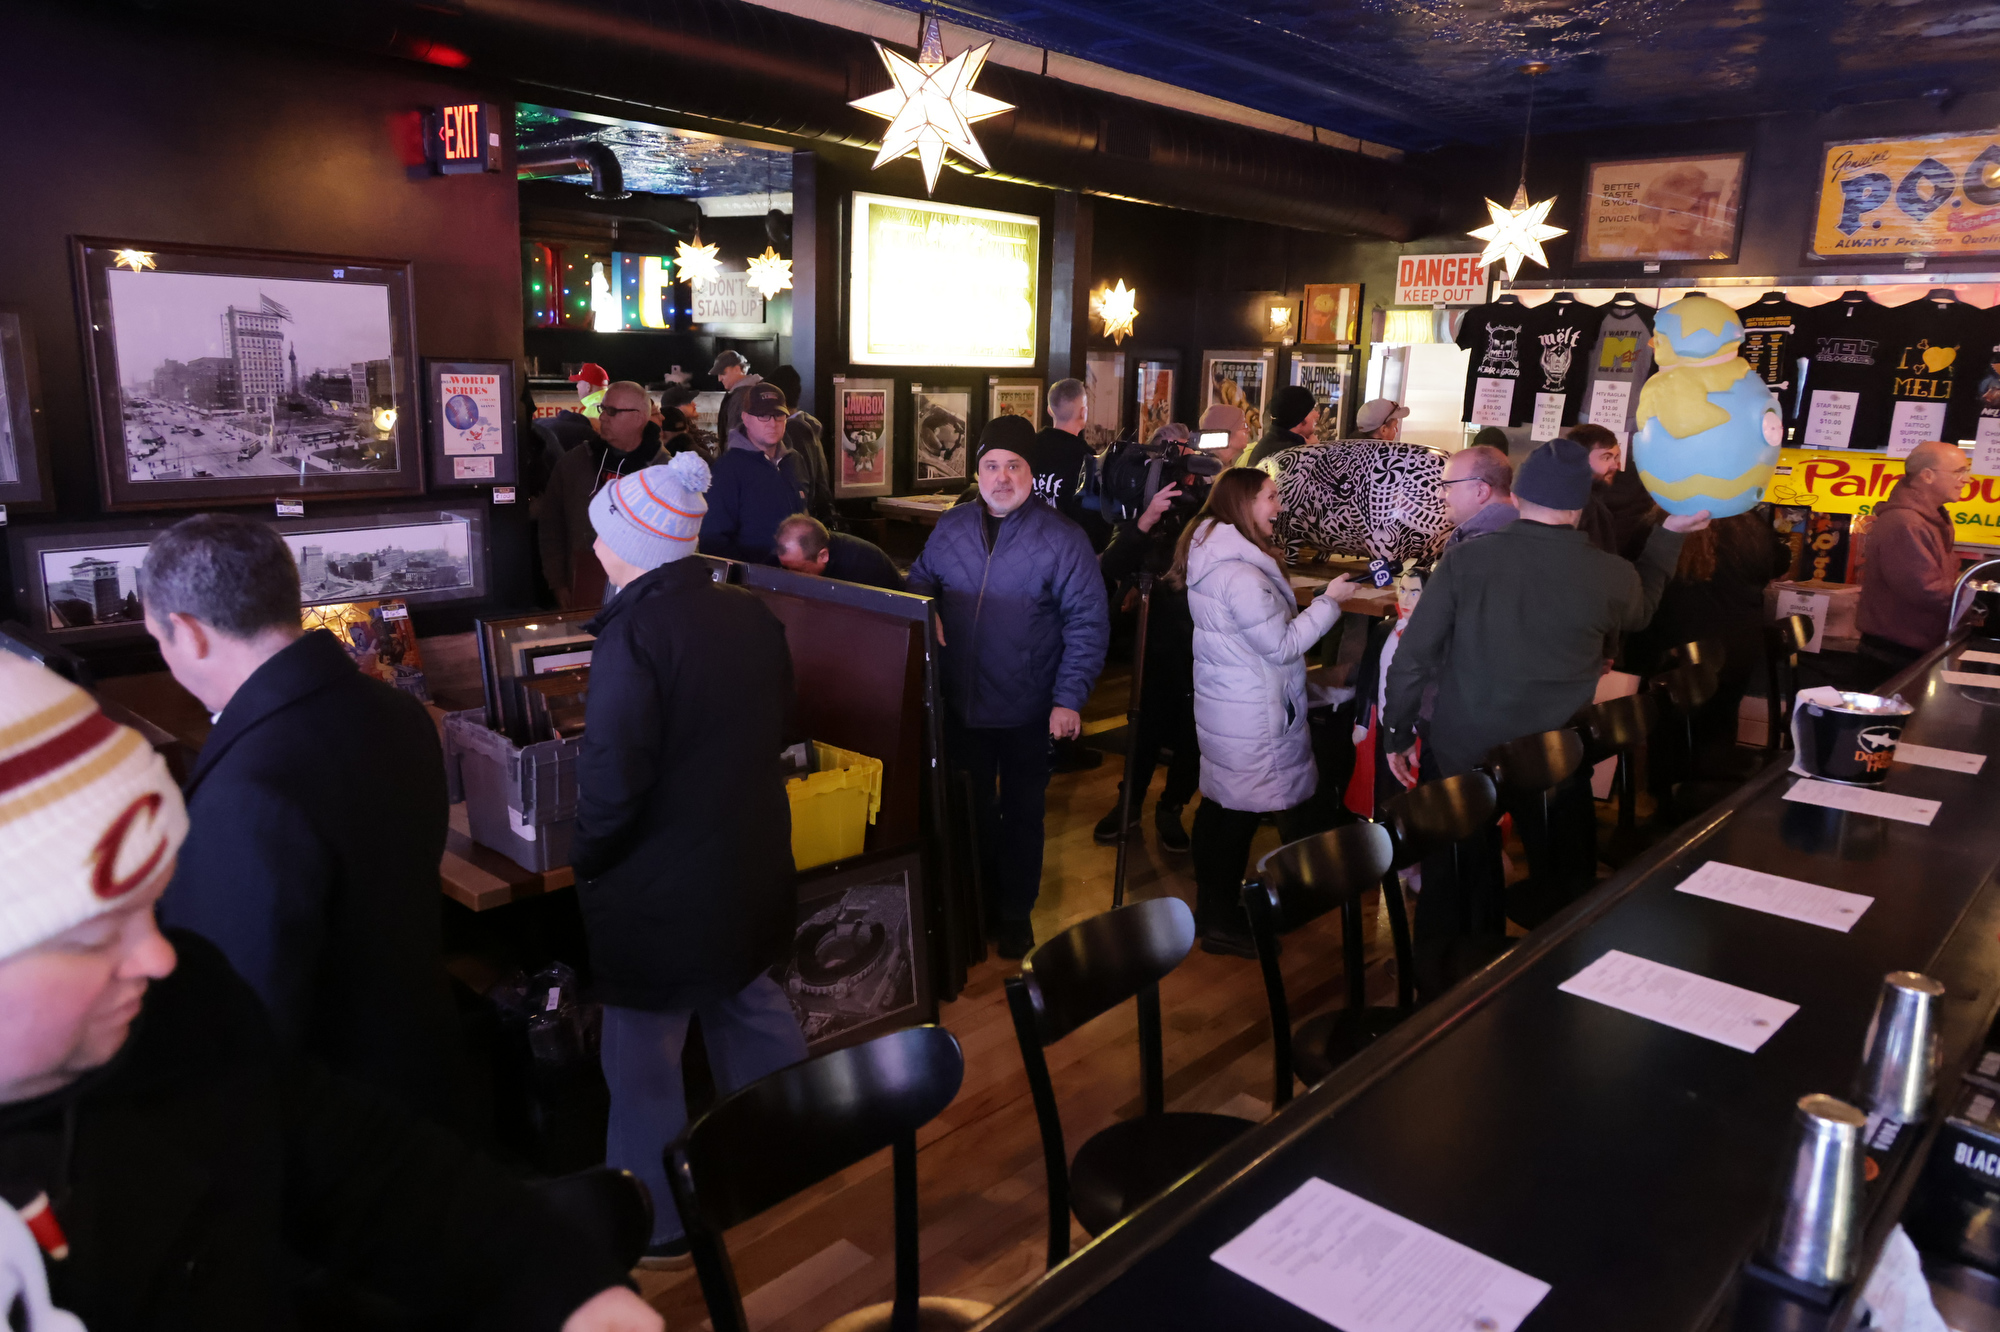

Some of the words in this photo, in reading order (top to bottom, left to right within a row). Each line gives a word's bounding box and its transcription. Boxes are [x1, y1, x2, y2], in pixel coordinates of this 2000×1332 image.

[444, 104, 479, 159] EXIT
[1832, 150, 1892, 183] Genuine
[1400, 258, 1484, 287] DANGER
[709, 279, 745, 296] DON'T
[1404, 289, 1439, 302] KEEP
[1443, 289, 1474, 301] OUT
[698, 300, 737, 316] STAND
[742, 300, 757, 316] UP
[1897, 347, 1913, 369] I
[450, 376, 495, 385] WORLD
[1892, 377, 1952, 399] MELT
[445, 386, 488, 395] SERIES
[845, 396, 884, 414] JAWBOX
[1981, 407, 2000, 418] MEL
[88, 791, 168, 900] C
